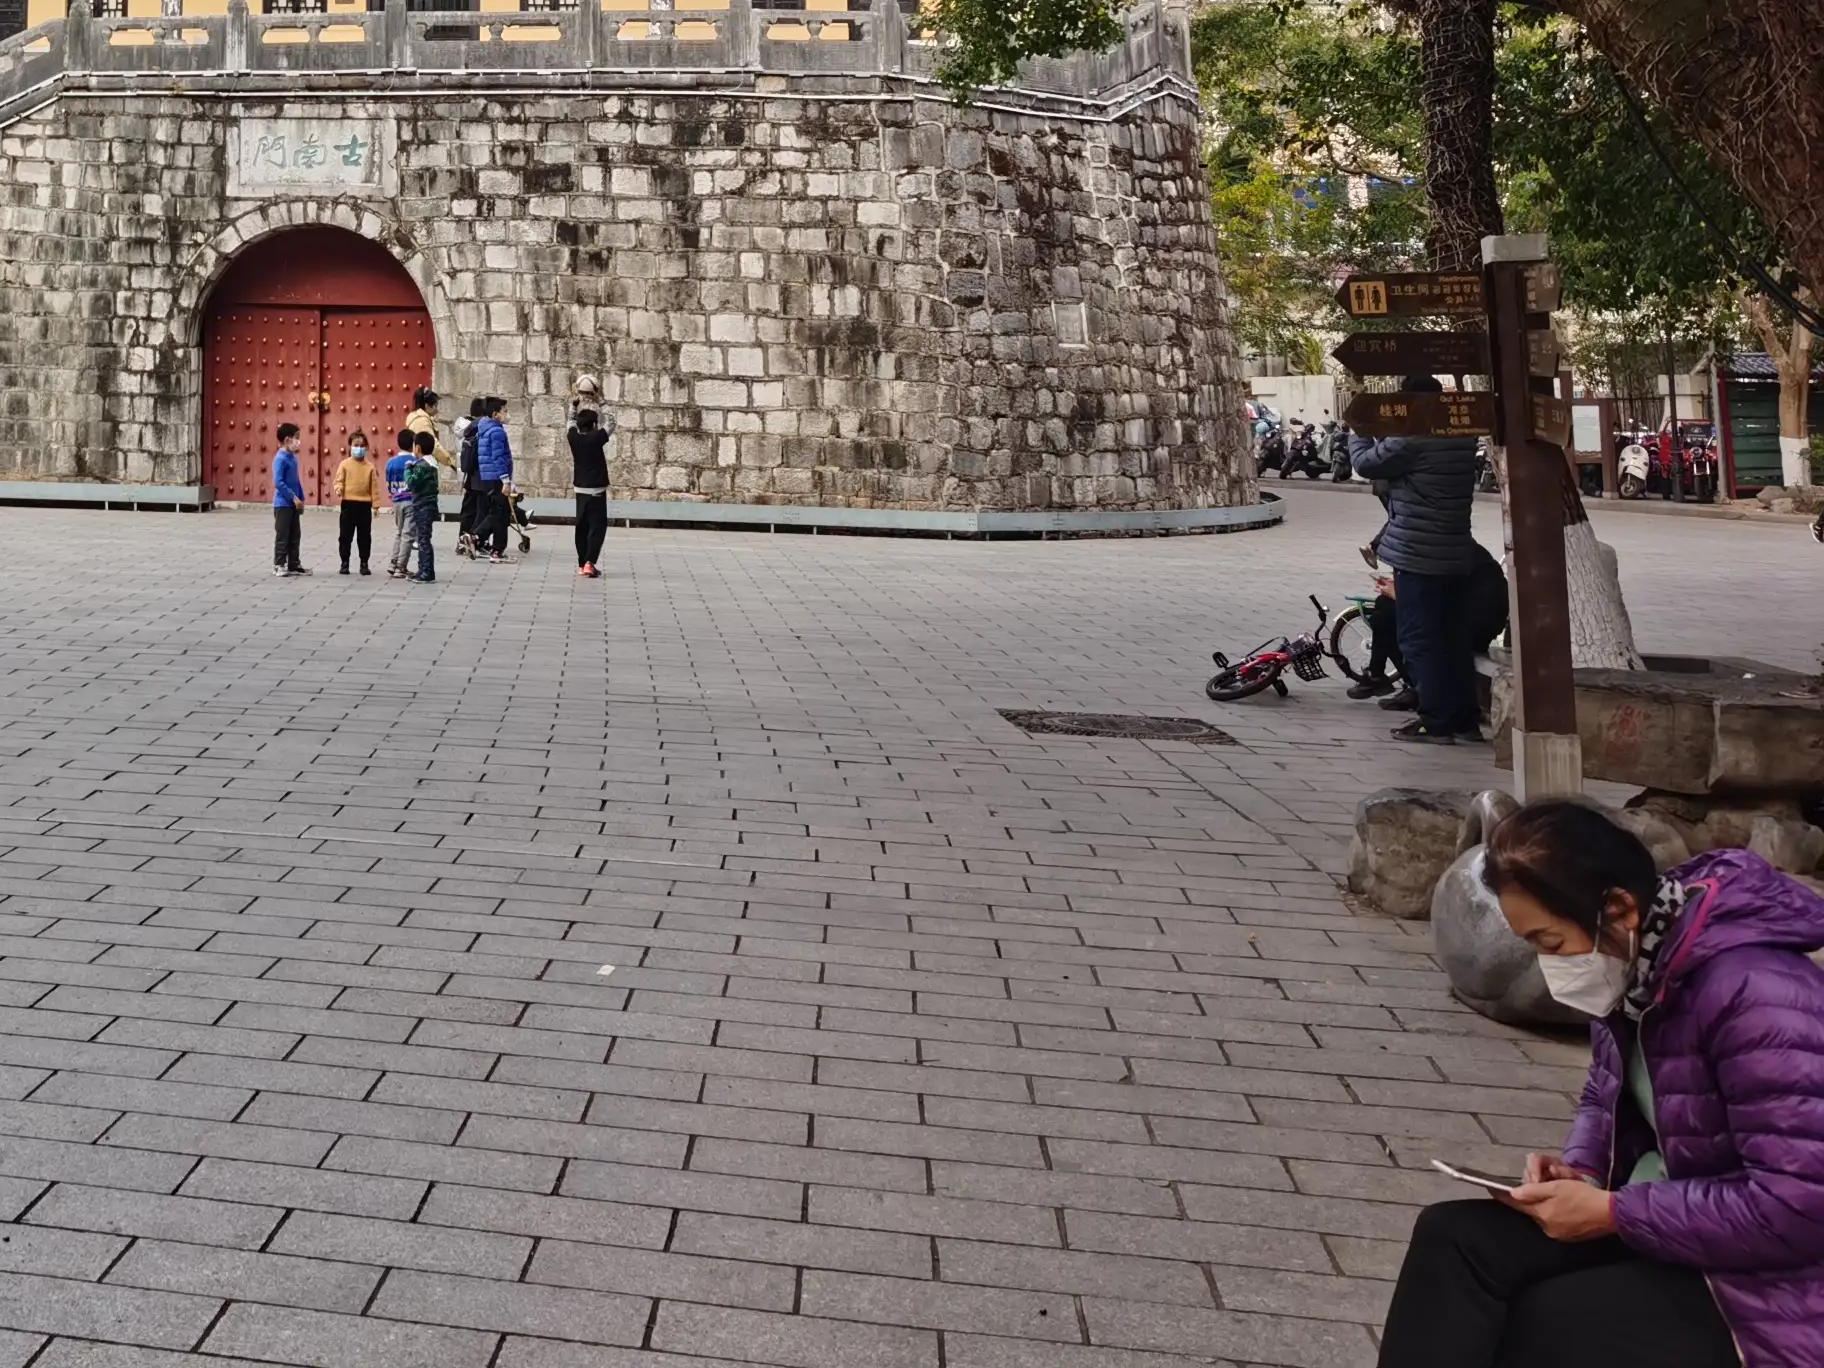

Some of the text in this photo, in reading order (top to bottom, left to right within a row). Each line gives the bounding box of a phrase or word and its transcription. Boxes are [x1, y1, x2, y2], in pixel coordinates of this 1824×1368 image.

[1390, 283, 1430, 296] 卫生间
[1379, 403, 1408, 417] 桂湖
